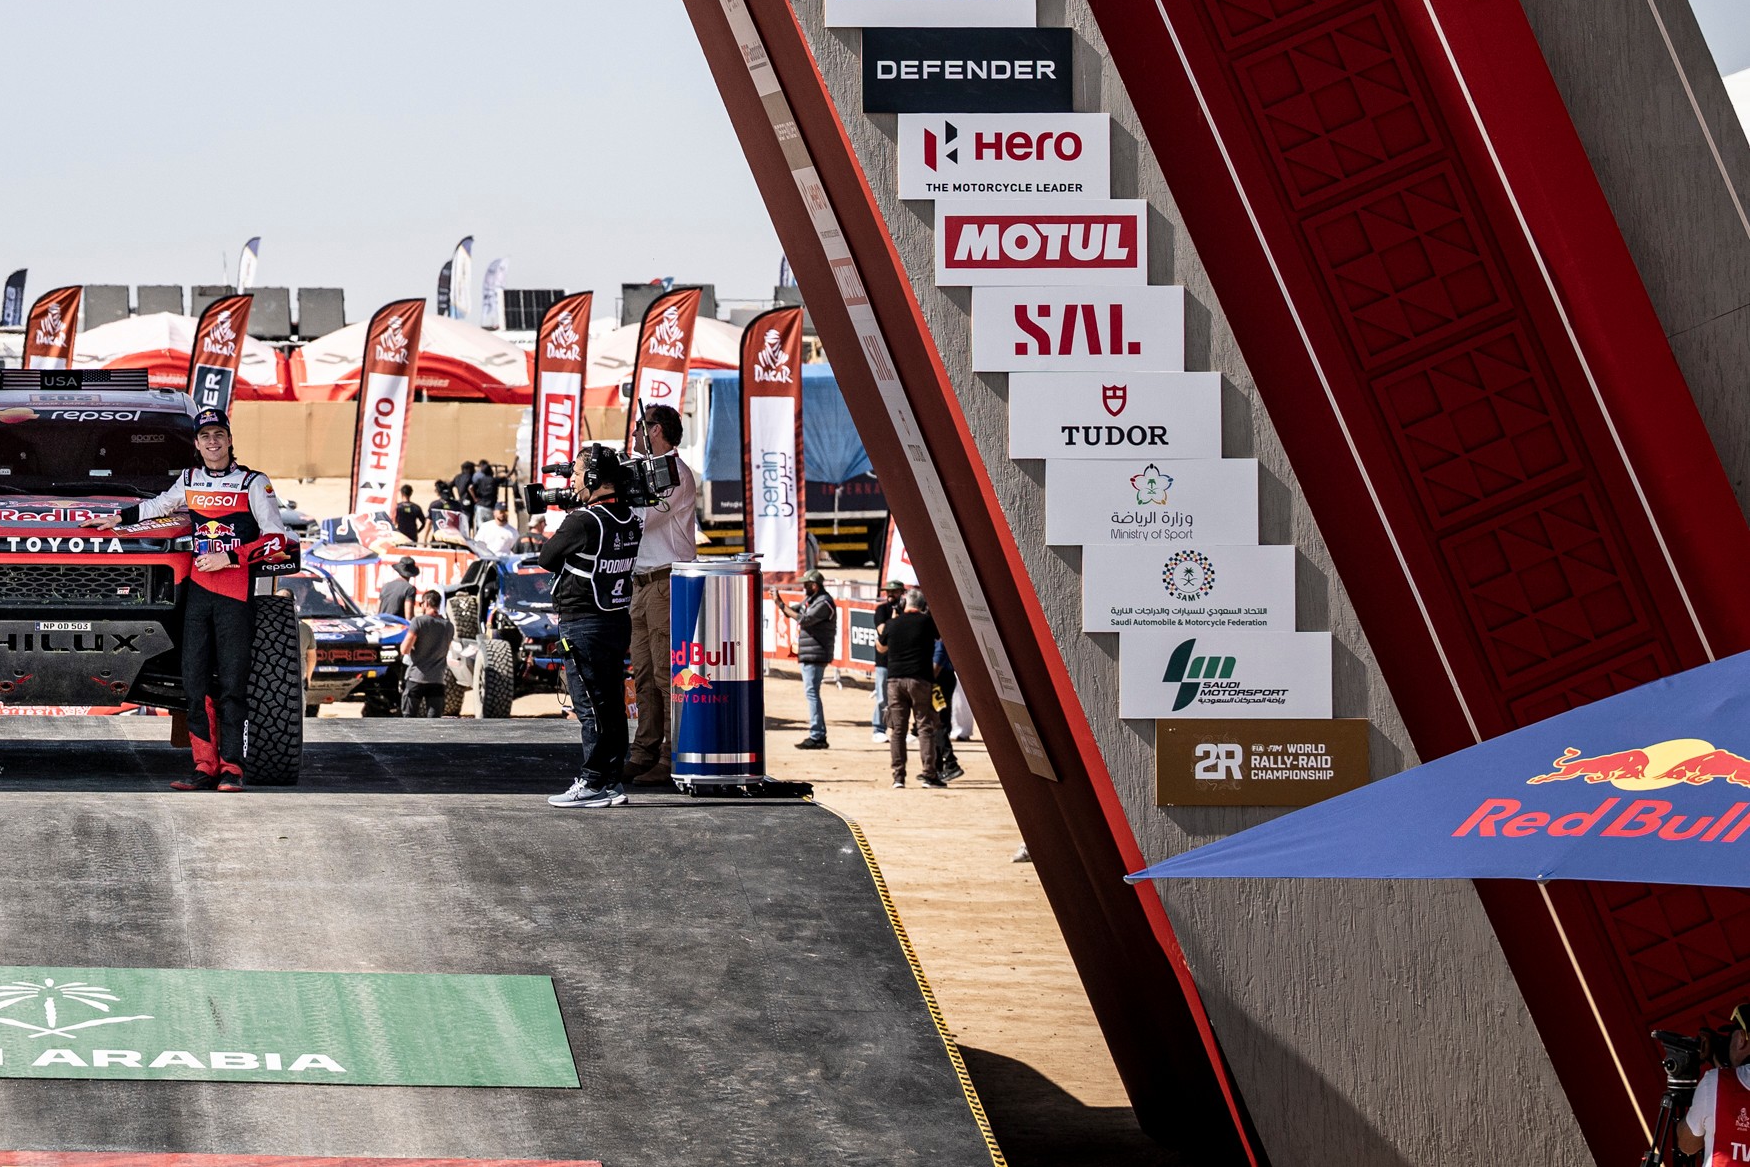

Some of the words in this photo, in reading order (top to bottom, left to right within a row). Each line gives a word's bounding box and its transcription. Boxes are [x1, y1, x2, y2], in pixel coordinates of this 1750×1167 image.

[876, 60, 1057, 80] DEFENDER
[974, 131, 1083, 162] Hero
[926, 183, 949, 192] THE
[952, 183, 1032, 193] MOTORCYCLE
[1036, 183, 1083, 193] LEADER
[953, 223, 1129, 261] MOTUL
[36, 329, 67, 348] DAKAR
[203, 338, 236, 358] DAKAR
[375, 343, 410, 365] DAKAR
[546, 342, 582, 362] DAKAR
[649, 341, 685, 360] DAKAR
[44, 376, 78, 387] USA
[753, 363, 793, 384] DAKAR
[51, 410, 142, 422] repsol
[370, 397, 395, 470] Hero
[1061, 425, 1169, 446] TUDOR
[756, 450, 779, 518] berain
[191, 493, 238, 509] repsol
[1111, 511, 1156, 527] الرياضة
[1161, 512, 1193, 527] وزارة
[1110, 528, 1149, 541] Ministry
[1151, 528, 1162, 539] of
[1164, 529, 1193, 541] Sport
[7, 537, 124, 553] TOYOTA
[262, 563, 296, 571] repsol
[599, 558, 633, 574] PODIUM
[1176, 592, 1201, 602] SAMF
[1206, 607, 1242, 617] السعودي
[1185, 619, 1226, 628] Motorcycle
[851, 626, 877, 647] DEFE
[689, 641, 735, 667] Bull
[692, 694, 730, 704] DRINK
[1251, 744, 1265, 753] FIA
[1287, 744, 1326, 754] WORLD
[1194, 743, 1243, 780] 2R
[1251, 755, 1331, 768] RALLY-RAID
[1251, 769, 1334, 780] CHAMPIONSHIP
[1451, 797, 1621, 837] Red
[1600, 799, 1750, 843] Bull
[30, 1047, 347, 1073] ARABIA
